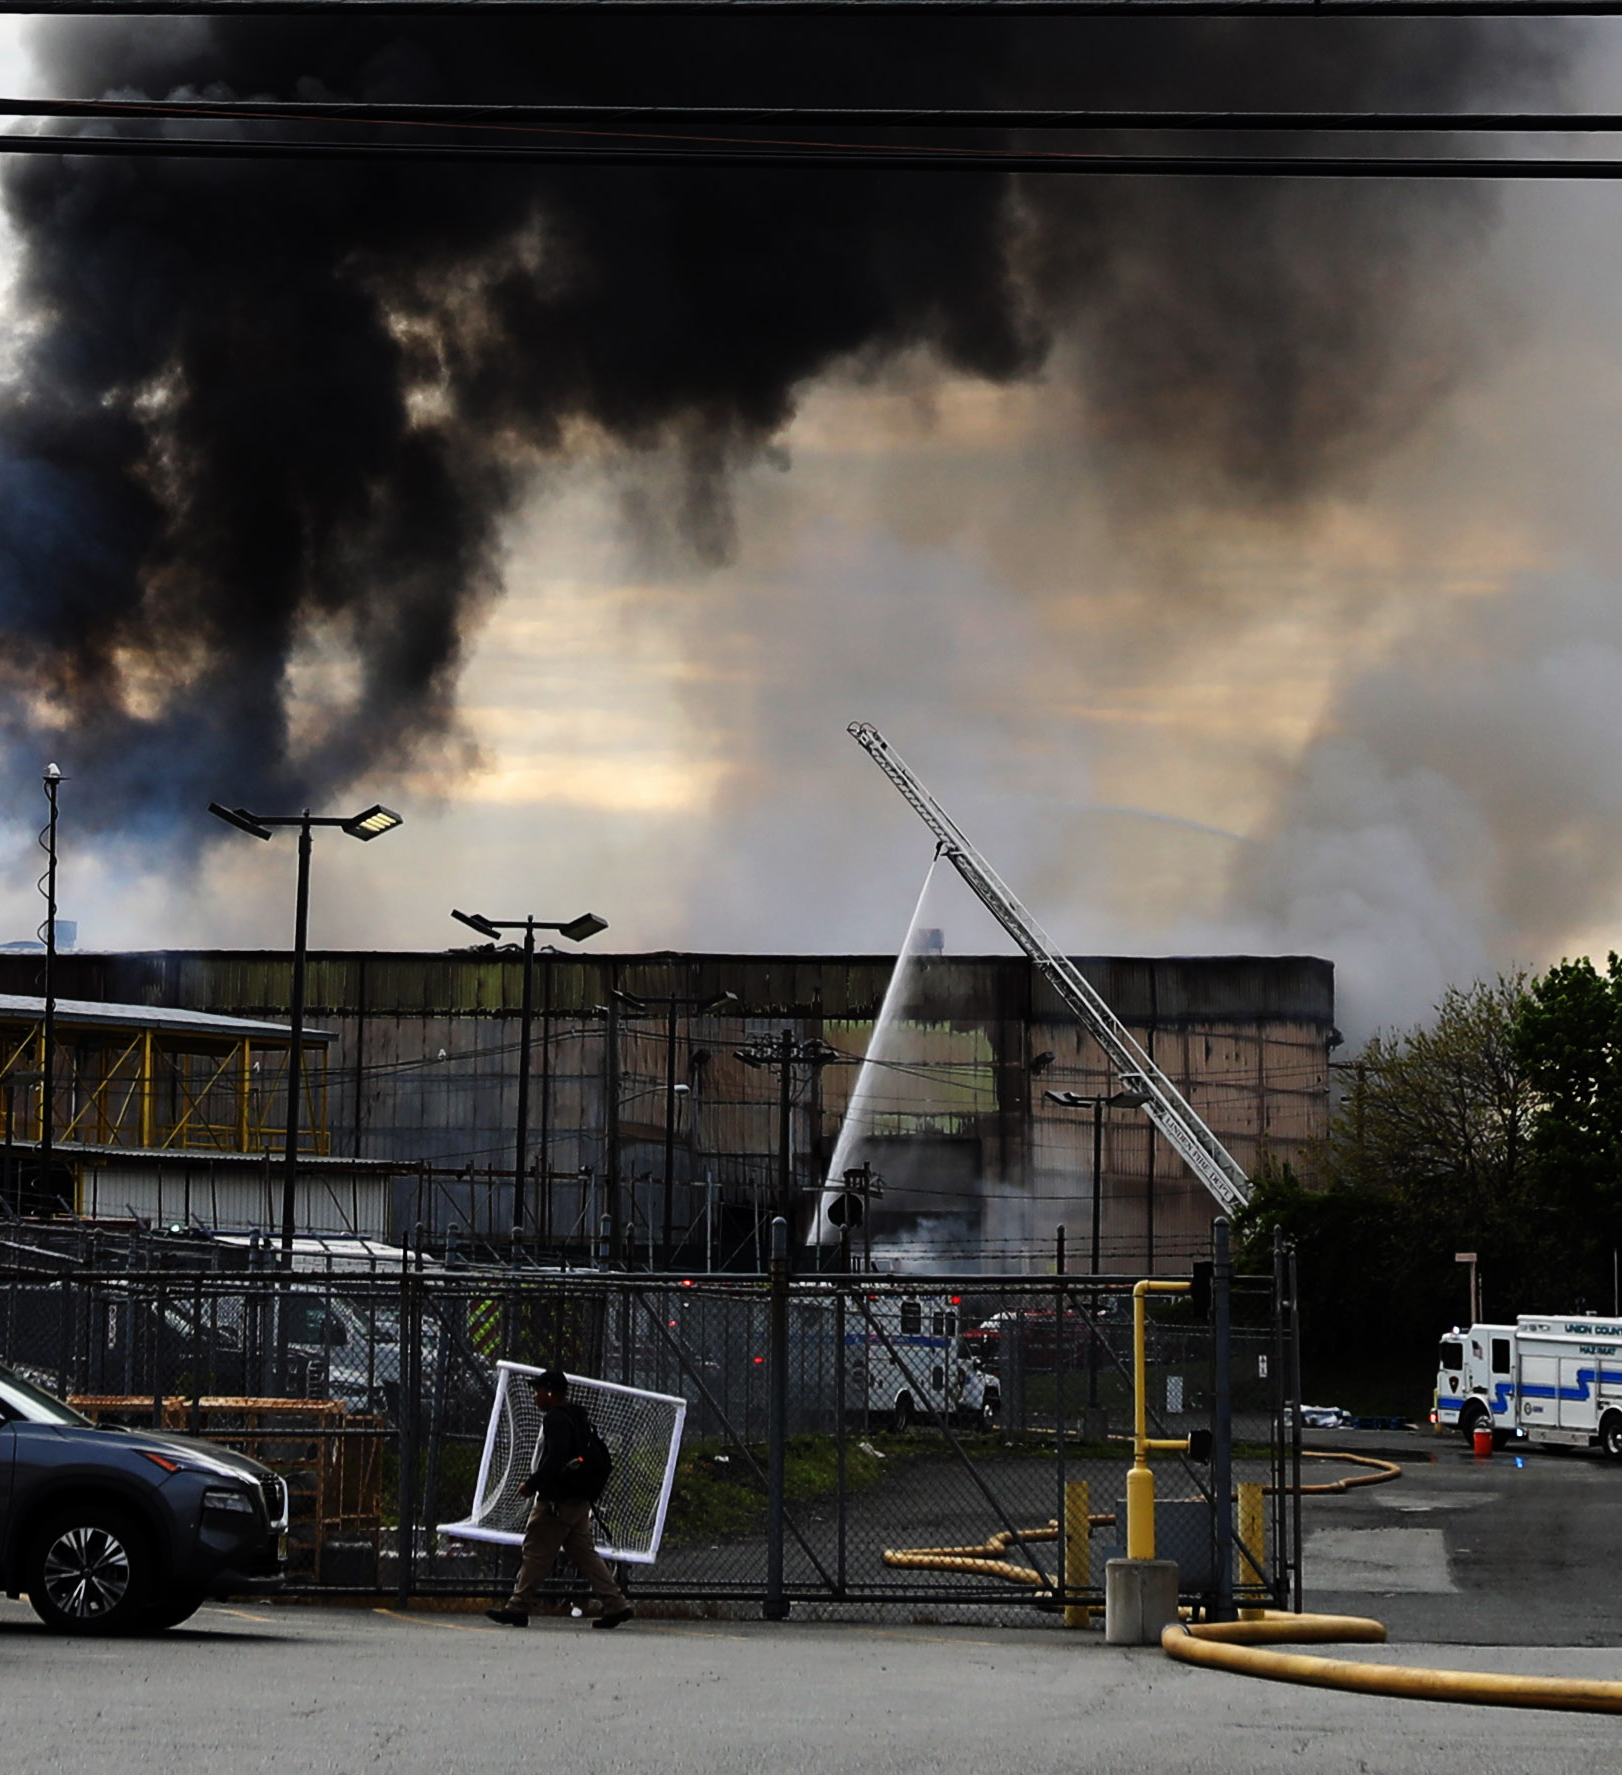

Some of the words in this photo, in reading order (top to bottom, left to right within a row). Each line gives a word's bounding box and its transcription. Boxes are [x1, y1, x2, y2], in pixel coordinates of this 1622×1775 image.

[1165, 1117, 1193, 1152] LINDEN
[1192, 1150, 1211, 1173] FIRE
[1565, 1324, 1593, 1335] UNION
